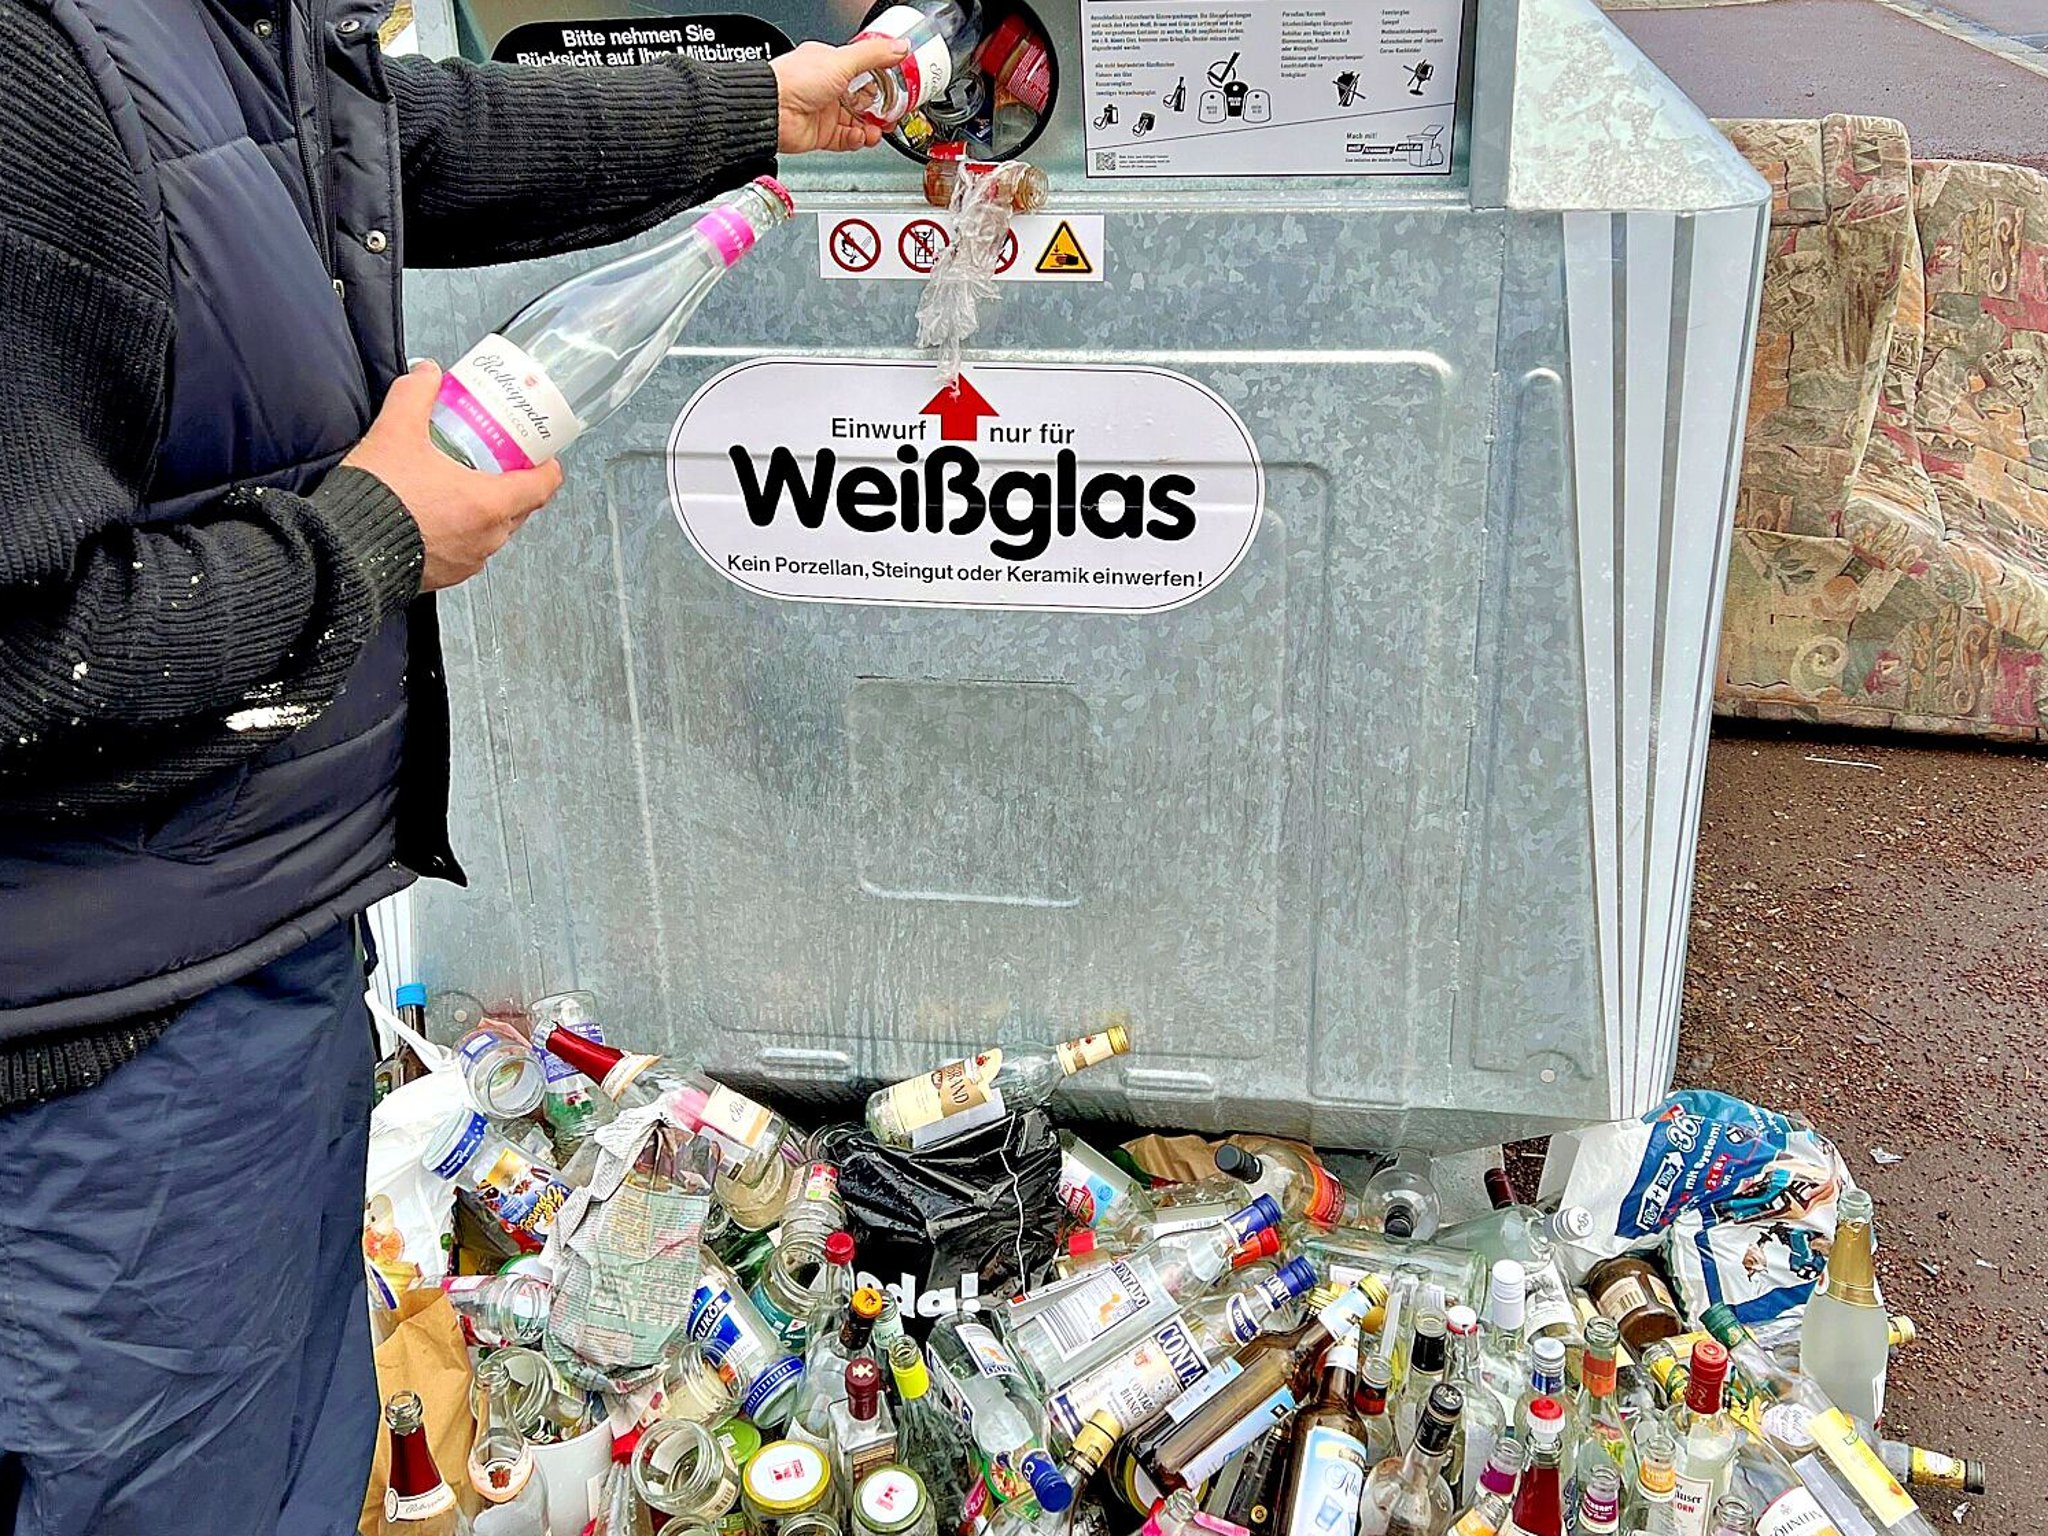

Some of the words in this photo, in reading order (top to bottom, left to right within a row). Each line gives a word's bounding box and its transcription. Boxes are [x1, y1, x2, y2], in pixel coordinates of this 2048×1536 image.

[562, 29, 605, 48] Bitte
[610, 26, 682, 46] nehmen
[686, 24, 715, 42] Sie
[517, 50, 602, 67] Rücksicht
[607, 47, 635, 66] auf
[831, 418, 926, 441] Einwurf
[989, 426, 1031, 442] nur
[1039, 422, 1075, 444] für
[728, 444, 1197, 562] Weißglas
[727, 554, 770, 573] Kein
[775, 556, 869, 579] Porzellan,
[872, 561, 953, 584] Steingut
[957, 564, 1002, 582] oder
[1007, 565, 1089, 585] Keramik
[1093, 570, 1204, 589] einwerfen!
[1157, 1322, 1205, 1388] CONTA
